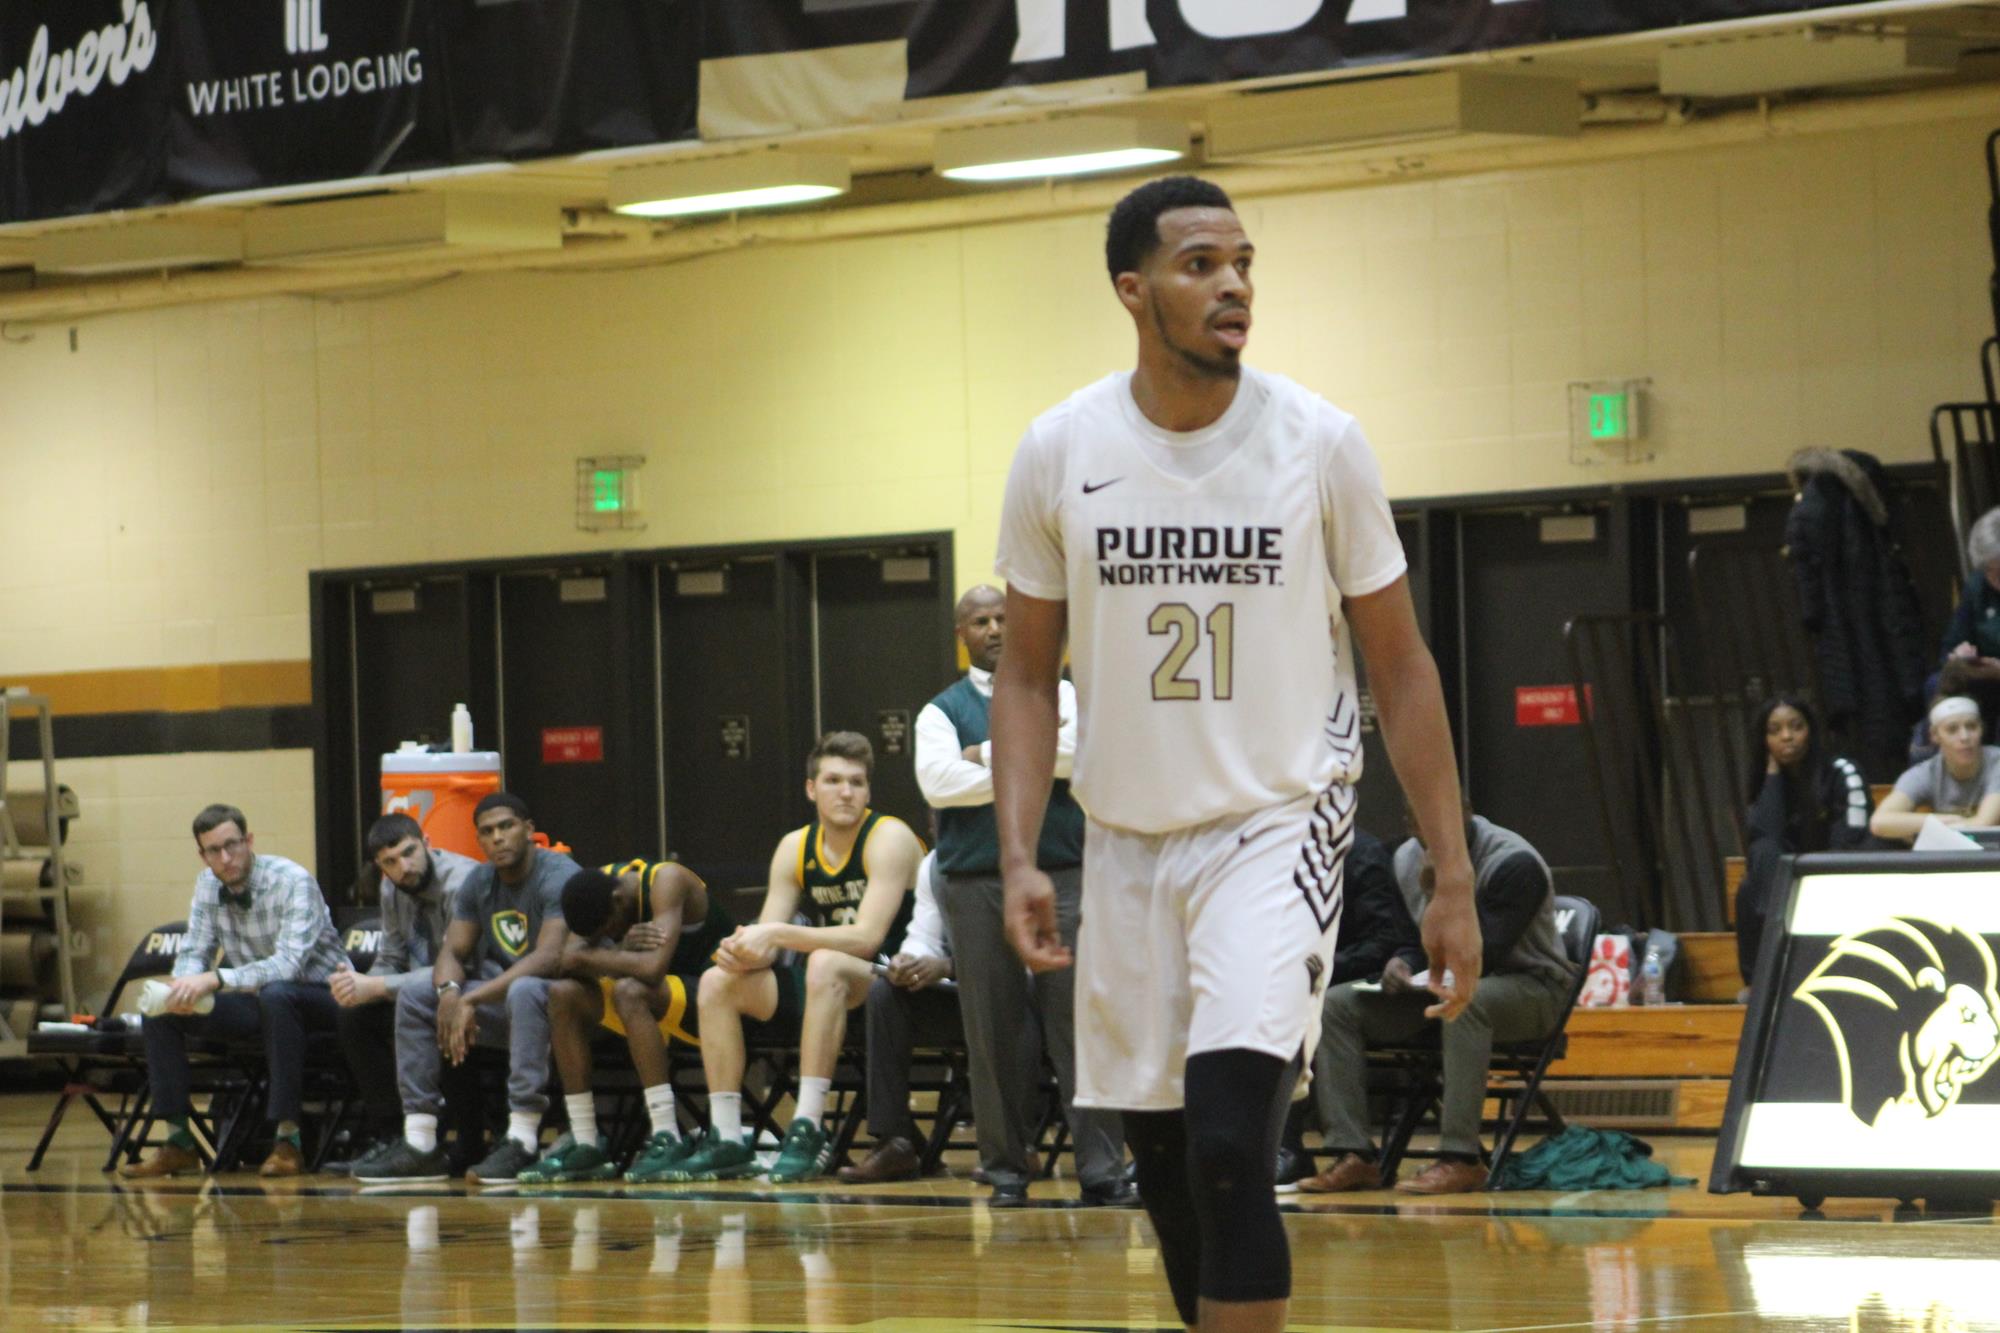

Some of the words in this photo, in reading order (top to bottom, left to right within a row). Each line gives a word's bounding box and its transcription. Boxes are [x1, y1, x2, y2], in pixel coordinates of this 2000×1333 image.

[187, 71, 285, 116] WHITE
[292, 47, 423, 103] LODGING
[1096, 526, 1283, 561] PURDUE
[1099, 563, 1283, 586] NORTHWEST
[1147, 602, 1234, 701] 21
